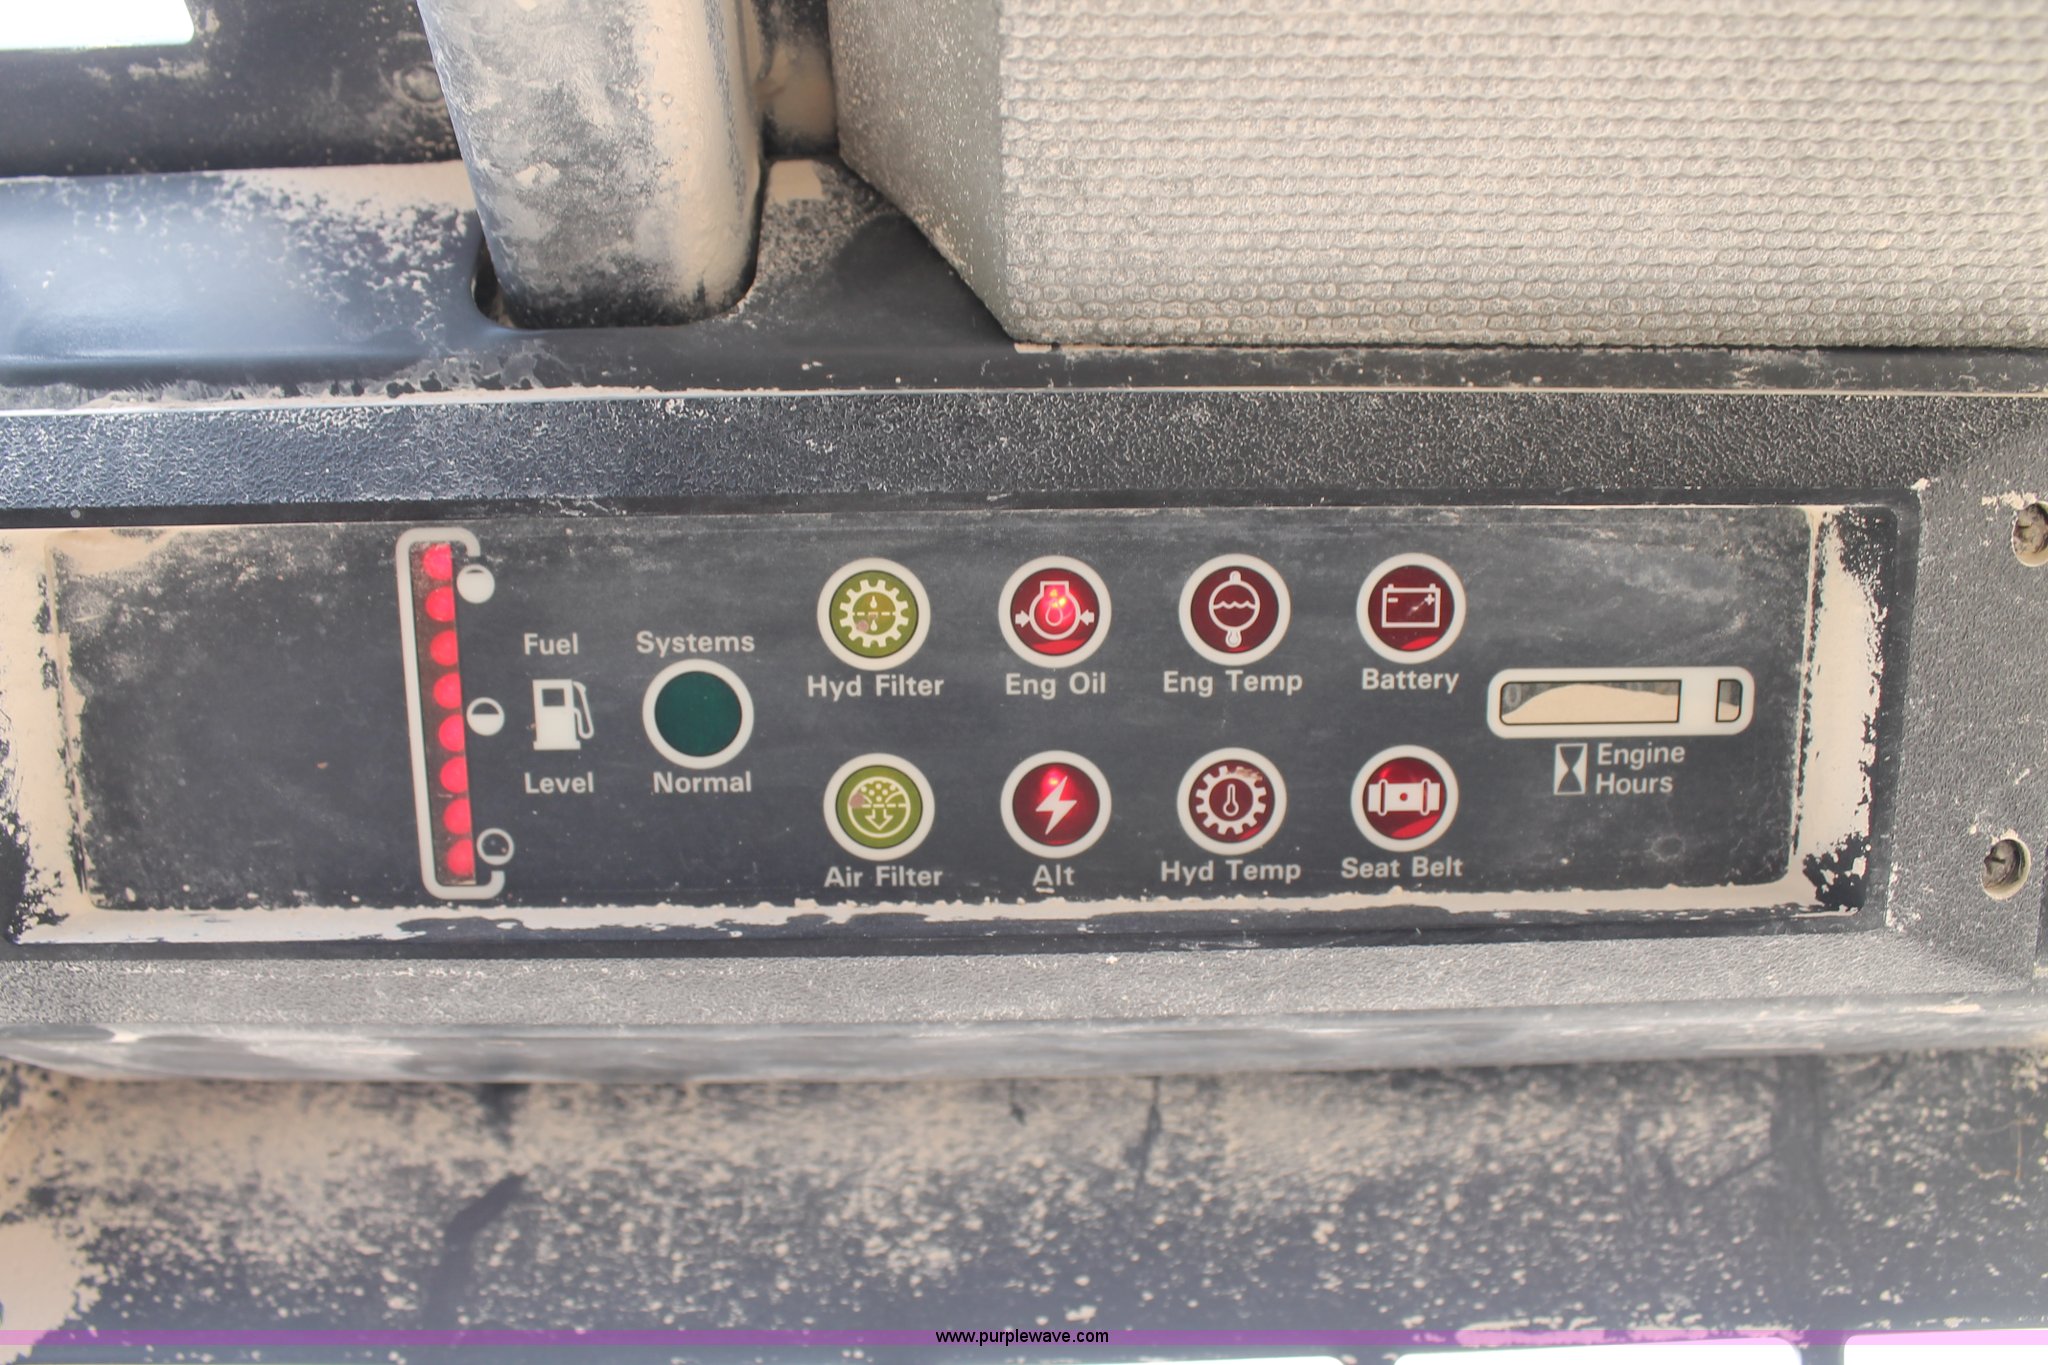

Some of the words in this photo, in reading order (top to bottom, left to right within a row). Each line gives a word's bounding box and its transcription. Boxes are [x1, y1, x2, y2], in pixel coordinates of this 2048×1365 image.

[523, 633, 579, 655] Fuel
[636, 631, 755, 658] Systems
[807, 675, 862, 701] Hyd
[875, 674, 944, 697] Filter
[1005, 672, 1056, 699] Eng
[1069, 672, 1106, 695] Oil
[1163, 670, 1214, 697] Eng
[1226, 670, 1303, 695] Temp
[1361, 668, 1459, 694] Battery
[1597, 742, 1685, 770] Engine
[524, 773, 594, 794] Level
[652, 771, 752, 793] Normal
[1595, 773, 1674, 795] Hours
[824, 867, 863, 888] Air
[876, 867, 943, 888] Filter
[1032, 864, 1075, 887] Alt
[1161, 860, 1214, 885] Hyd
[1226, 860, 1301, 883] Temp
[1341, 857, 1400, 878] Seat
[1412, 856, 1464, 877] Belt
